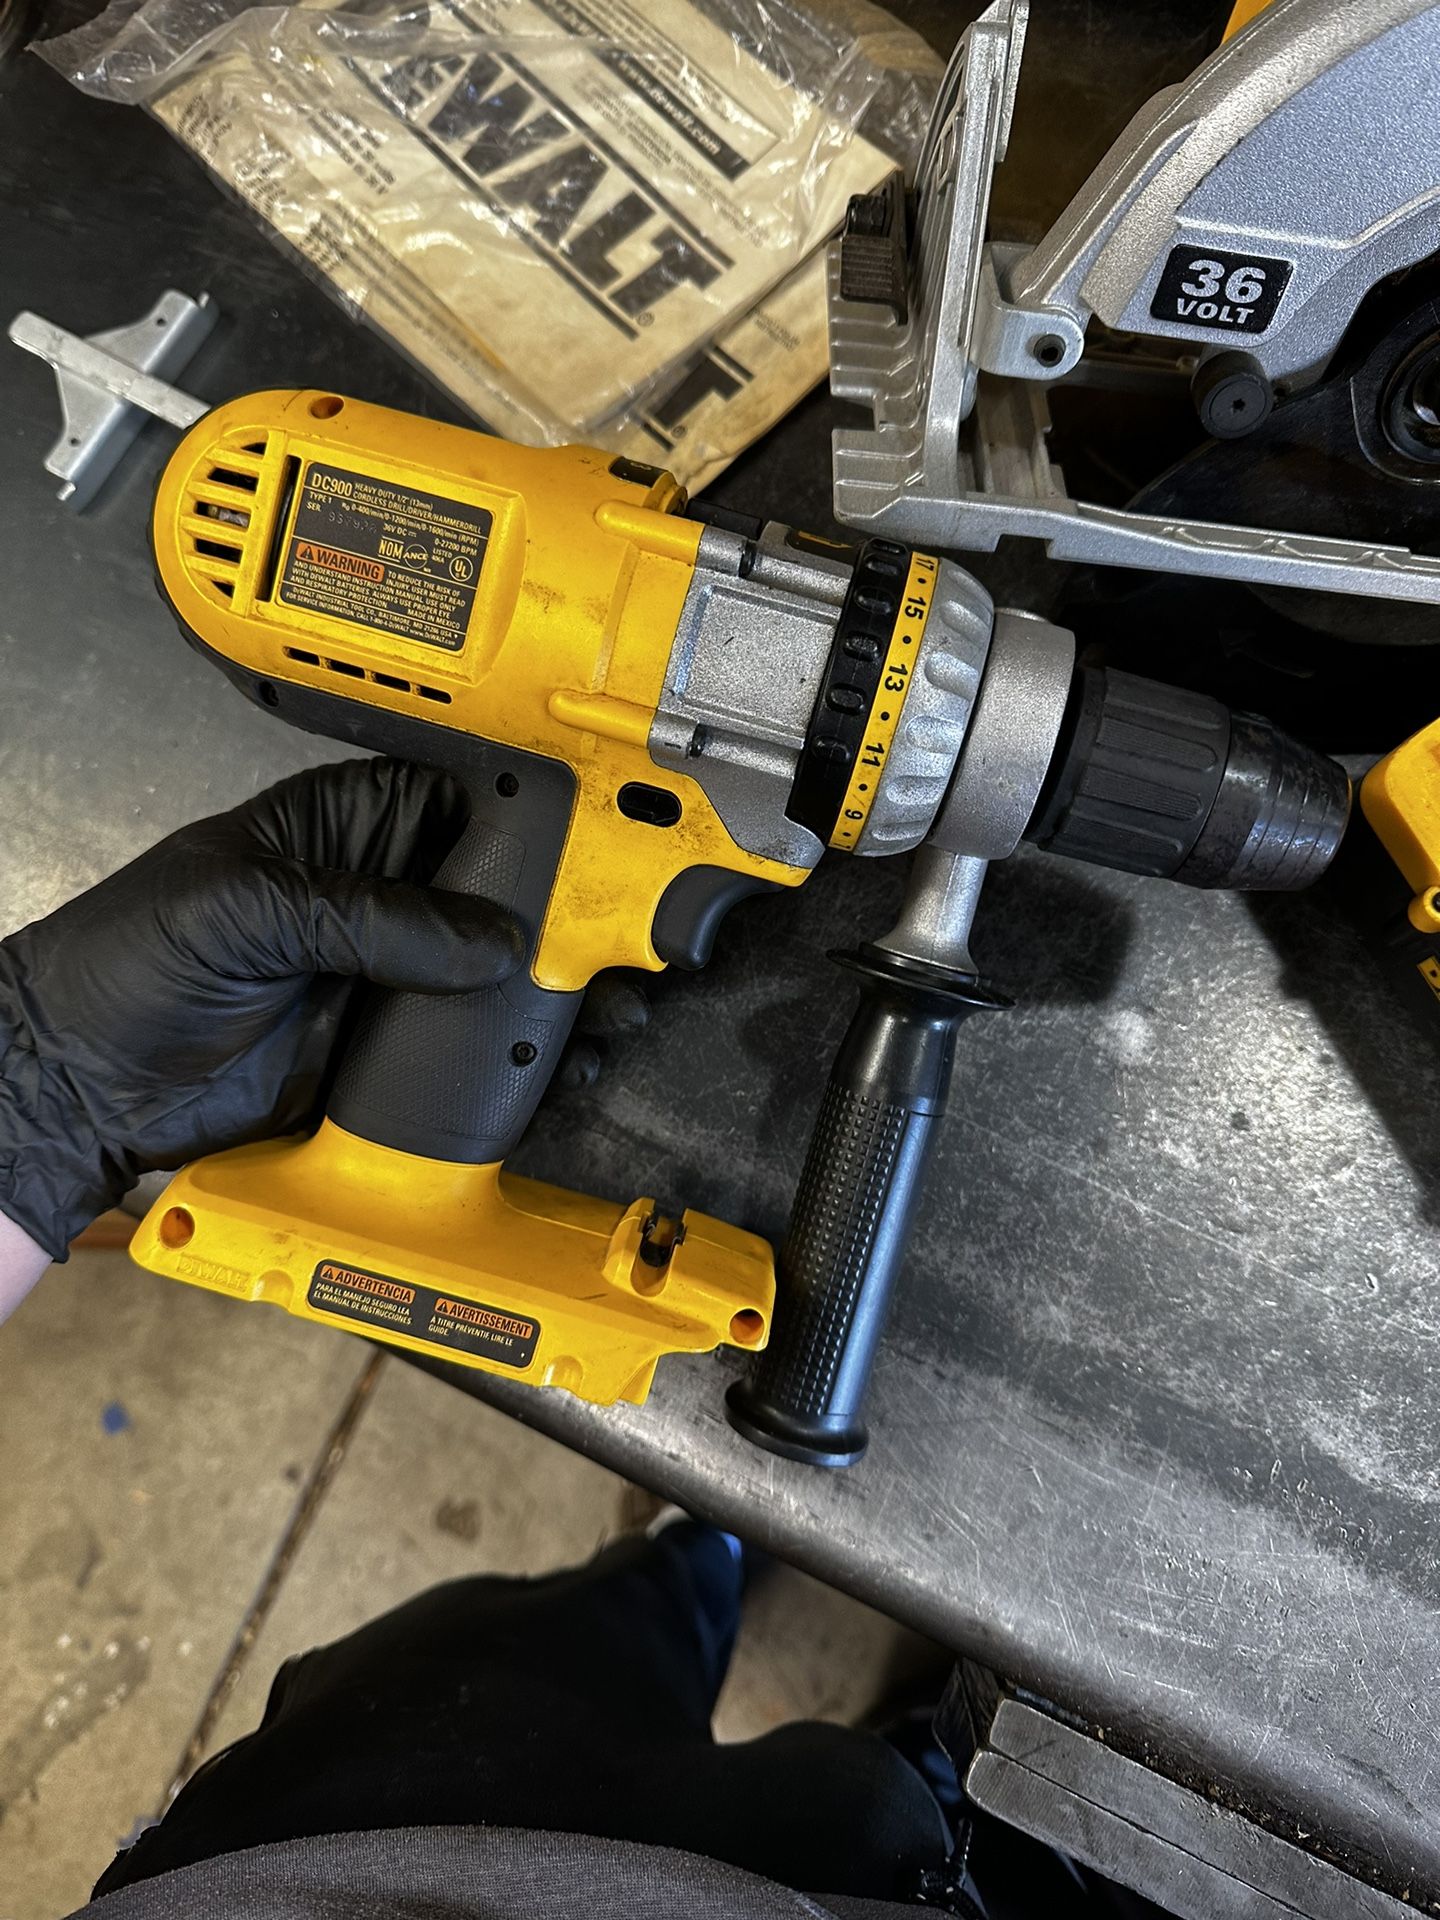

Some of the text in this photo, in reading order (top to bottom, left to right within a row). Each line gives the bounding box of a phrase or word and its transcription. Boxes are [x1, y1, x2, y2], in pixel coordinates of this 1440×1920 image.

[1182, 259, 1266, 304] 36
[1176, 298, 1254, 325] VOLT
[312, 473, 353, 496] DC900
[355, 483, 376, 494] HEAVY
[378, 489, 396, 500] DUTY
[309, 492, 326, 502] TYPE
[353, 491, 387, 506] CORDLESS
[397, 527, 407, 536] DC
[379, 540, 403, 559] NOM
[404, 549, 429, 564] ANCE
[433, 548, 452, 558] LISTED
[461, 546, 477, 556] BPM
[316, 549, 380, 579] WARNING
[453, 560, 469, 577] UL
[915, 557, 935, 572] 17
[290, 575, 304, 584] AND
[306, 580, 347, 596] RESPIRATORY
[292, 568, 309, 578] WITH
[372, 591, 398, 603] ALWAYS
[399, 599, 412, 607] USE
[413, 603, 437, 615] PROPER
[439, 610, 450, 618] EYE
[294, 560, 308, 569] AND
[309, 565, 351, 581] UNDERSTAND
[352, 577, 394, 594] INSTRUCTION
[425, 598, 438, 607] USE
[439, 602, 456, 612] ONLY
[387, 571, 396, 579] TO
[397, 574, 421, 586] REDUCE
[423, 581, 435, 590] THE
[436, 585, 451, 594] RISK
[297, 595, 317, 605] SERVICE
[356, 612, 369, 621] CALL
[316, 594, 349, 607] INDUSTRIAL
[351, 604, 364, 612] TOOL
[411, 586, 428, 596] USER
[429, 591, 447, 601] MUST
[448, 597, 465, 607] READ
[904, 596, 927, 620] 15
[407, 609, 426, 619] MADE
[436, 617, 460, 629] MEXICO
[883, 663, 909, 693] 13
[860, 742, 885, 768] 11
[844, 809, 864, 820] 9
[335, 1270, 411, 1302] ADVERTENCIA
[313, 1290, 412, 1325] EL MANUAL DE INSTRUCCIONES
[316, 1282, 409, 1315] PARA EL MANEJO SEGURO LEA
[437, 1317, 454, 1329] TITRE
[491, 1333, 504, 1343] LIRE
[505, 1337, 513, 1346] LE
[449, 1303, 530, 1337] AVERTISSEMENT
